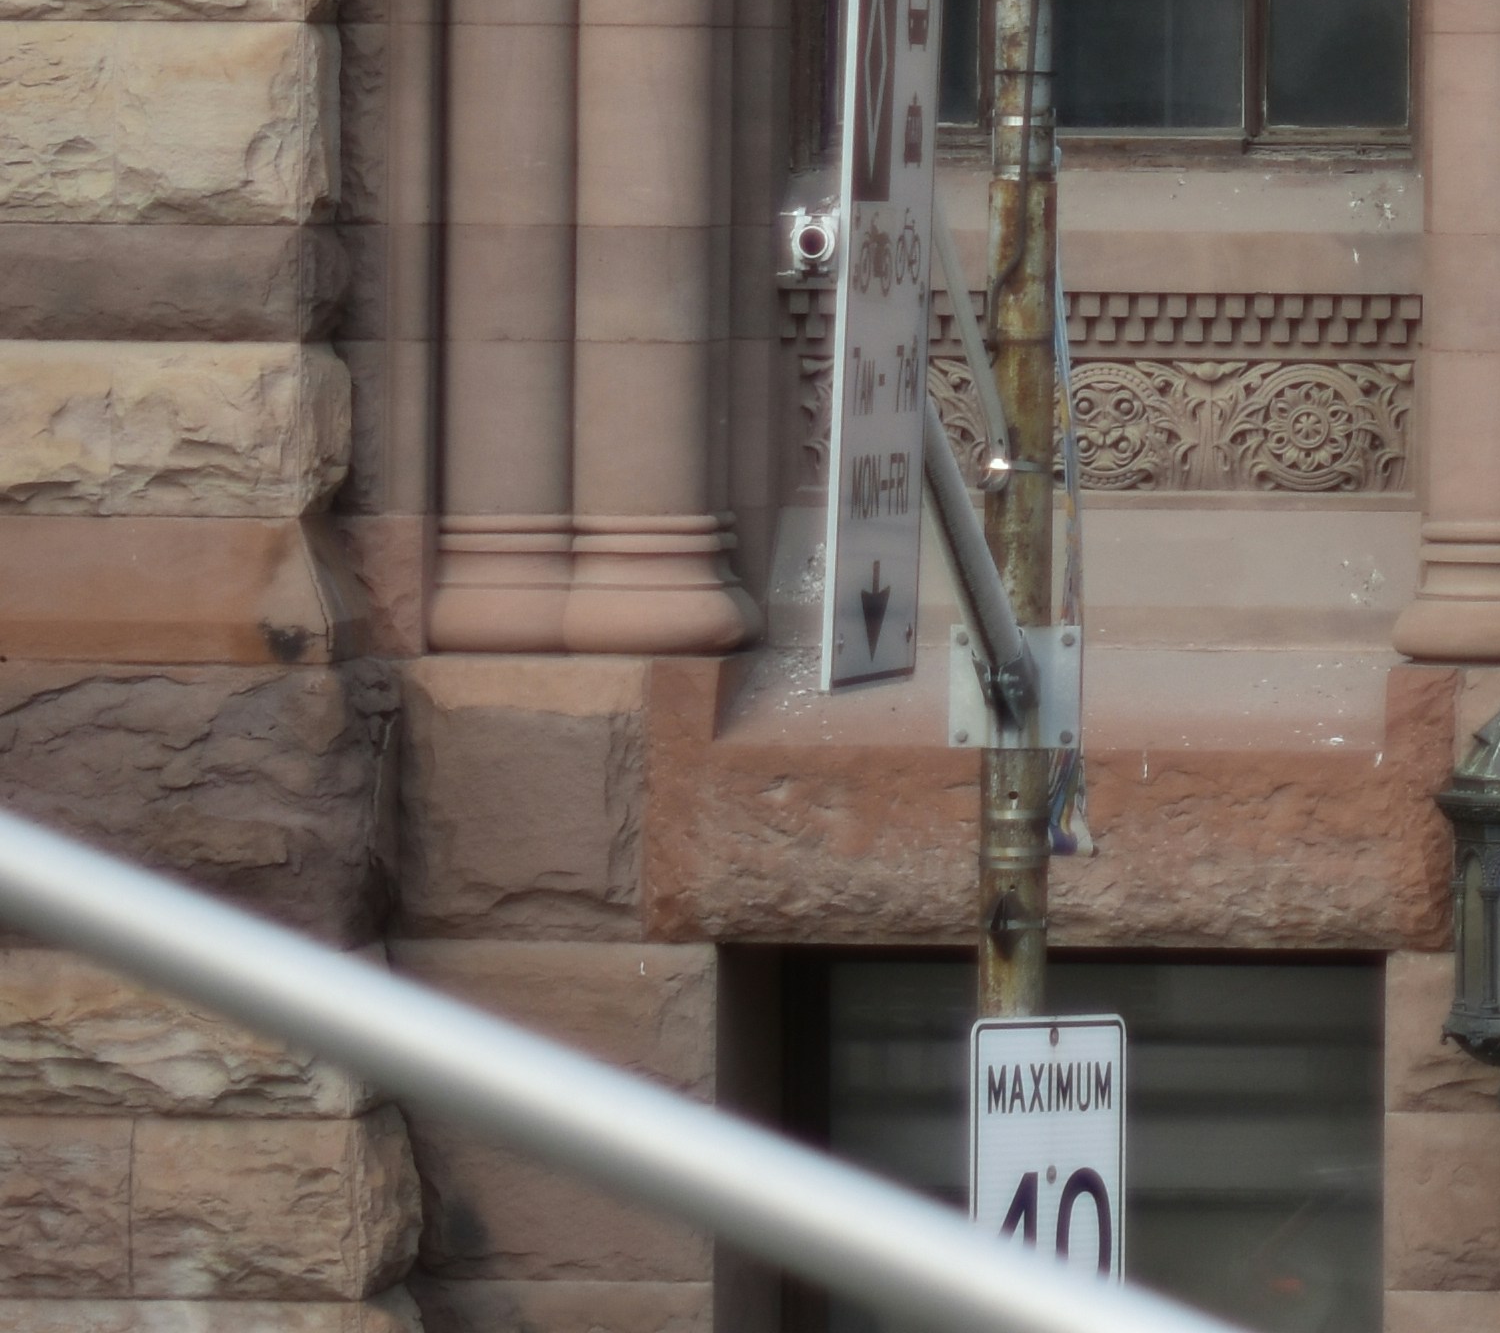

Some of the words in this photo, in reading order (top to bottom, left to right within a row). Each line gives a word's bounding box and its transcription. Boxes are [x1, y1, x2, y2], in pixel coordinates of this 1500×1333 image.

[851, 451, 911, 520] MON-FRI
[987, 1061, 1112, 1114] MAXIMUM
[998, 1167, 1113, 1280] 40
